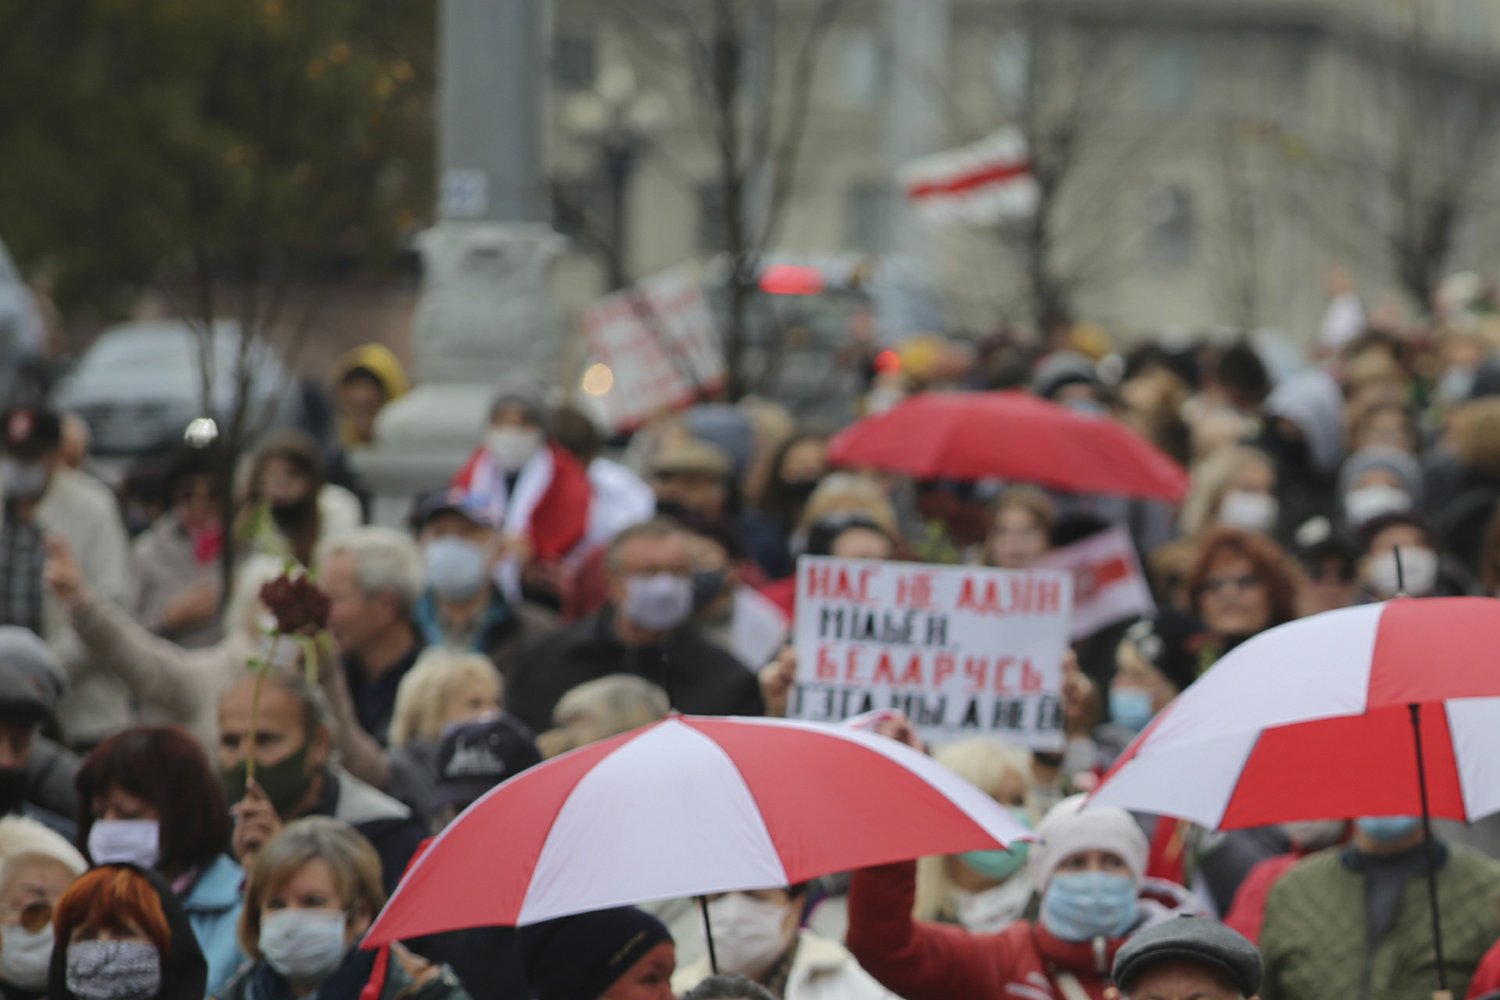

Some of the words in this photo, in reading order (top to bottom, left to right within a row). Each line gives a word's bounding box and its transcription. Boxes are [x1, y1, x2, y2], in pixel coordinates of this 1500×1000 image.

[807, 563, 878, 604] НАС
[896, 570, 940, 609] НЕ
[815, 643, 1044, 696] БЕЛАРУСЬ
[958, 693, 980, 730] А
